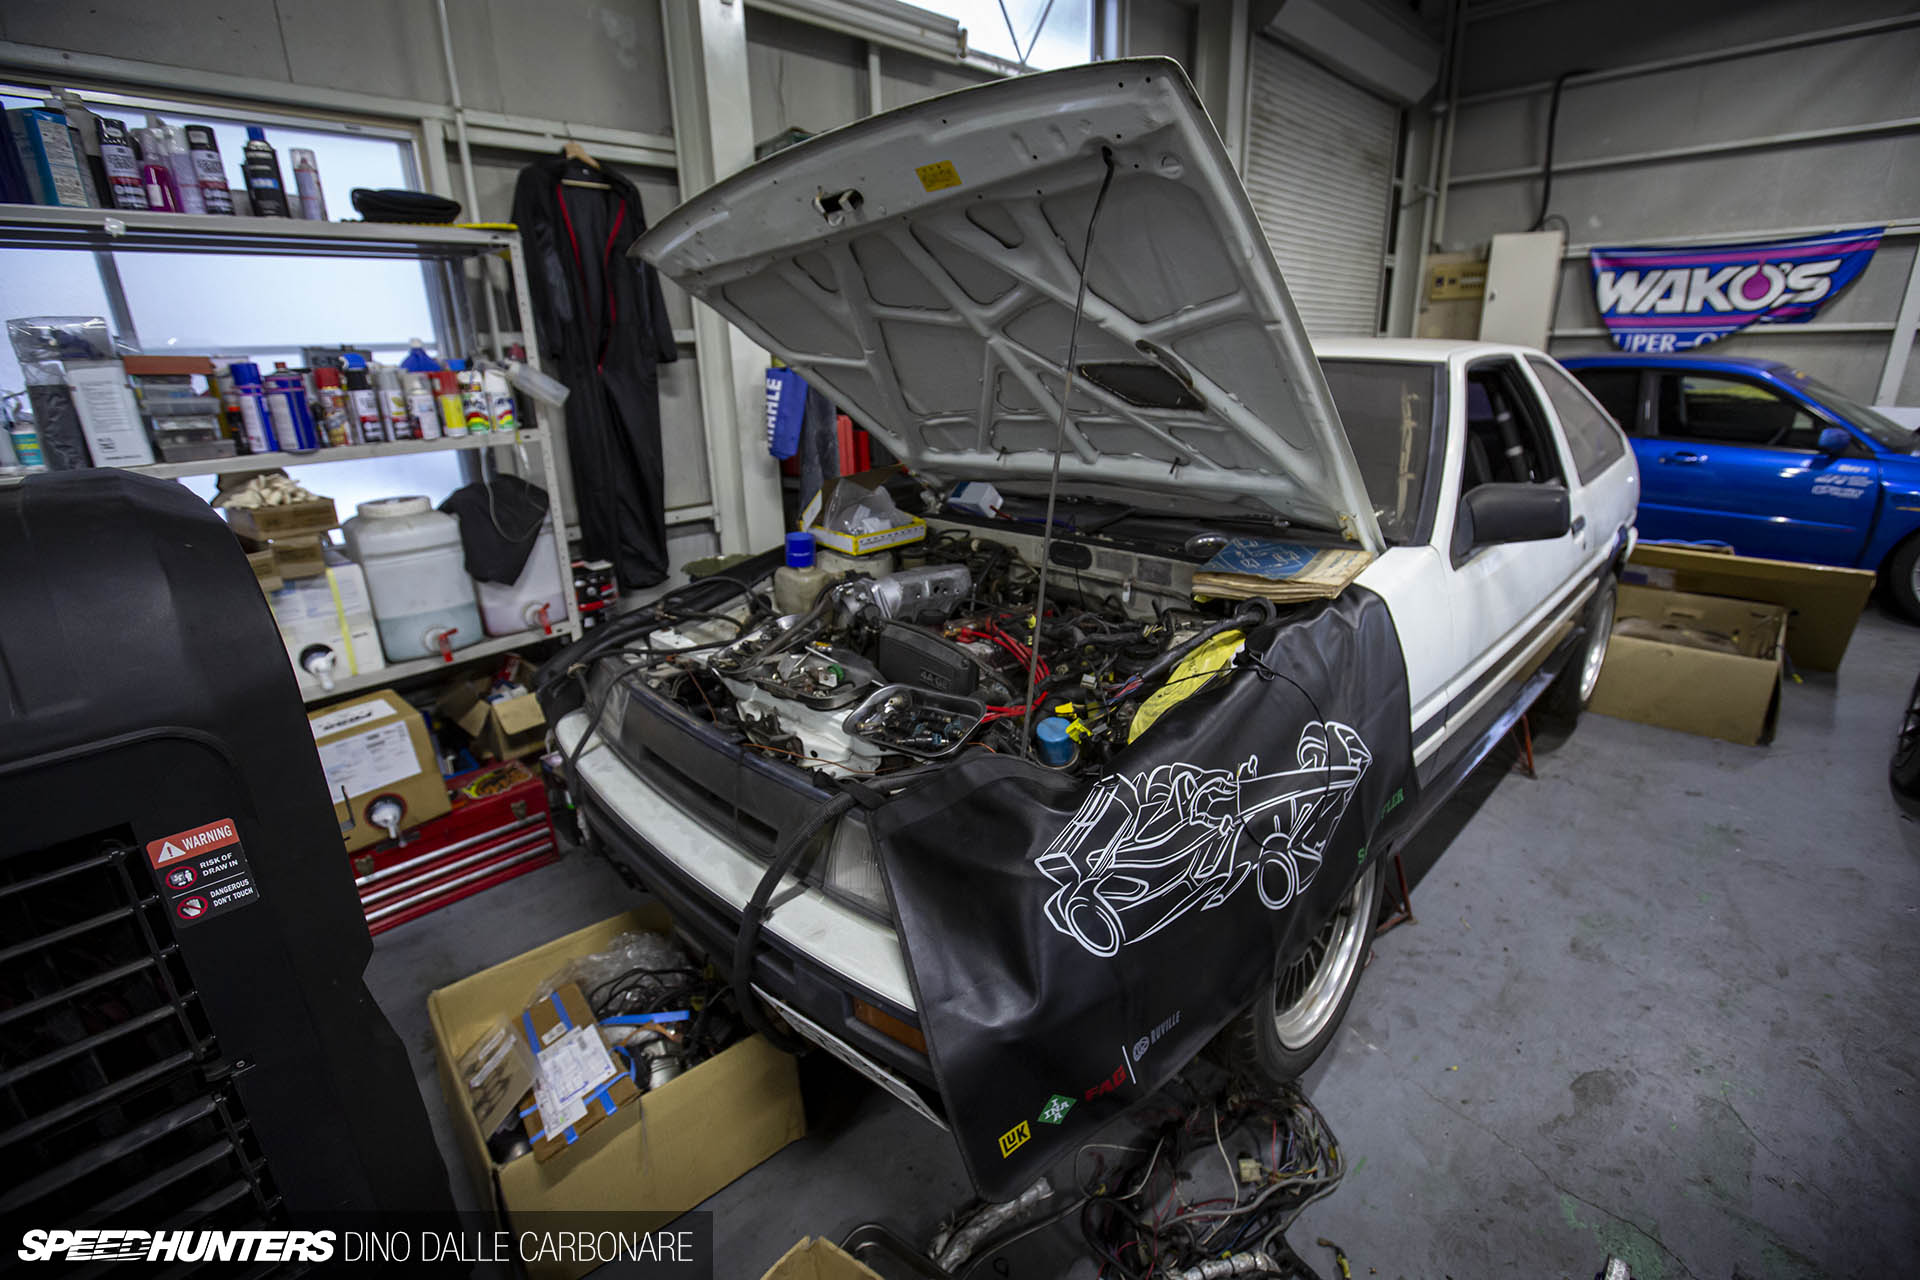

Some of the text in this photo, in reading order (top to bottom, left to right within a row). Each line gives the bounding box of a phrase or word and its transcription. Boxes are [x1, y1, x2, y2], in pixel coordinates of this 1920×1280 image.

[1596, 259, 1842, 315] WAKO'S
[182, 825, 232, 850] WARNING
[200, 852, 233, 869] RISK OF
[202, 859, 238, 877] DRAW IN
[210, 878, 250, 898] DANGEROUS
[213, 887, 254, 907] DON'T TOUCH
[1150, 1010, 1181, 1043] RUVILLE
[1084, 1064, 1127, 1102] FAG
